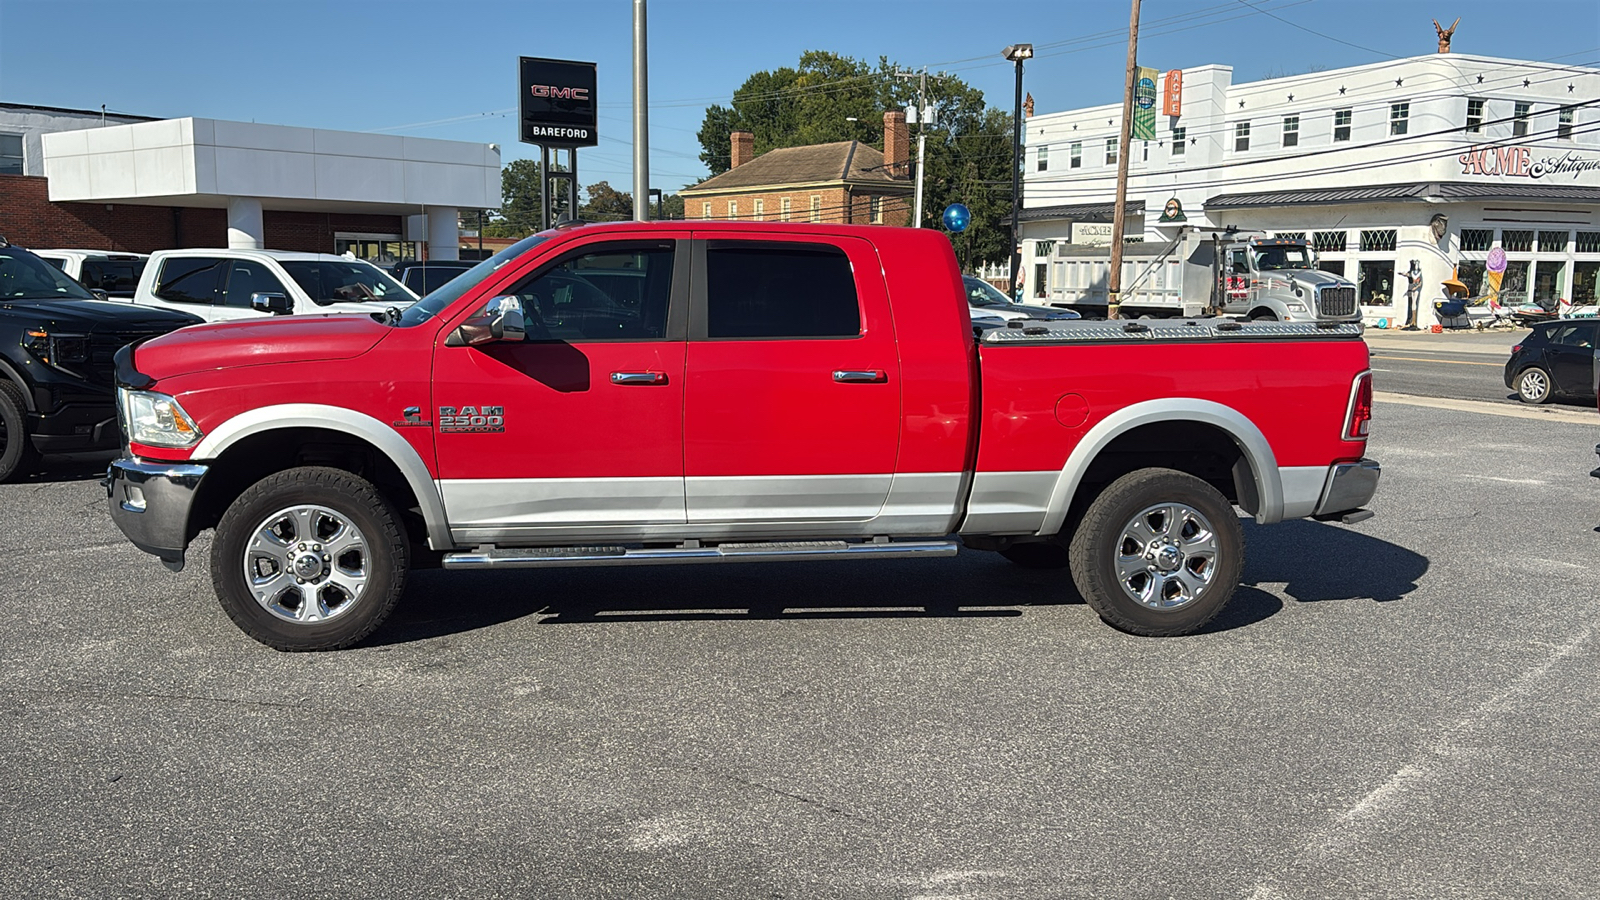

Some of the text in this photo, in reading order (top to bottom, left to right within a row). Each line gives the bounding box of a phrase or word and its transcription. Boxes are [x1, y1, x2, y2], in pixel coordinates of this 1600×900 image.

[531, 84, 589, 100] GMC
[1171, 73, 1180, 113] ACME
[533, 126, 588, 139] BAREFORD
[1460, 145, 1531, 177] ACME
[439, 406, 504, 416] RAM
[439, 415, 504, 427] 2500
